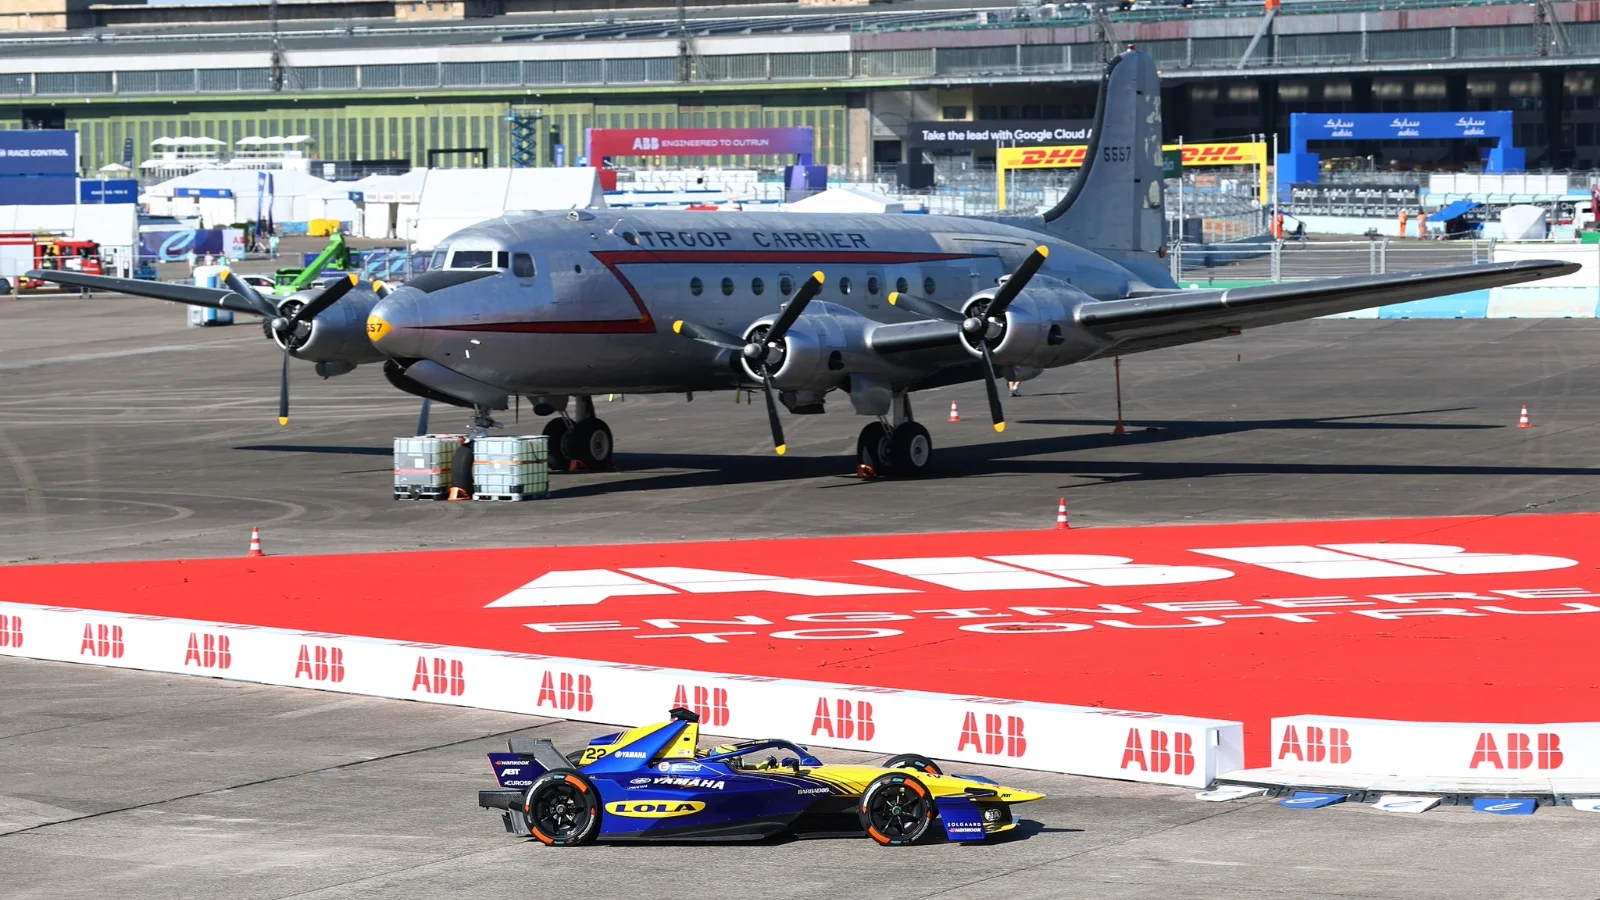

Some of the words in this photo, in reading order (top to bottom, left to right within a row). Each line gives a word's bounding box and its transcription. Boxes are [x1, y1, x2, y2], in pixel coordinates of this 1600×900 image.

[7, 149, 29, 157] RACE
[30, 149, 69, 157] CONTROL
[632, 137, 660, 150] ABB
[661, 139, 718, 147] ENGINEERED
[719, 139, 731, 147] TO
[732, 138, 769, 147] OUTRUN
[922, 130, 946, 141] Take
[947, 130, 965, 140] the
[967, 130, 988, 140] lead
[990, 130, 1013, 140] with
[1014, 129, 1053, 142] Google
[1054, 128, 1085, 139] Cloud
[1103, 146, 1132, 162] 5557
[639, 231, 732, 248] TROOP
[754, 231, 870, 249] CARRIER
[483, 543, 1578, 608] ABB
[81, 623, 124, 659] ABB
[185, 632, 232, 669] ABB
[633, 627, 905, 644] TO
[295, 644, 345, 683] ABB
[412, 656, 465, 696] ABB
[537, 670, 593, 712] ABB
[671, 684, 730, 727] ABB
[811, 697, 875, 742] ABB
[958, 711, 1027, 758] ABB
[586, 748, 607, 760] 22
[622, 751, 646, 759] YAMAHA
[1120, 727, 1195, 776] ABB
[1278, 724, 1352, 764] ABB
[1469, 732, 1564, 770] ABB
[501, 768, 521, 777] ABT
[653, 777, 725, 790] YAMAHA
[614, 803, 697, 813] LOLA
